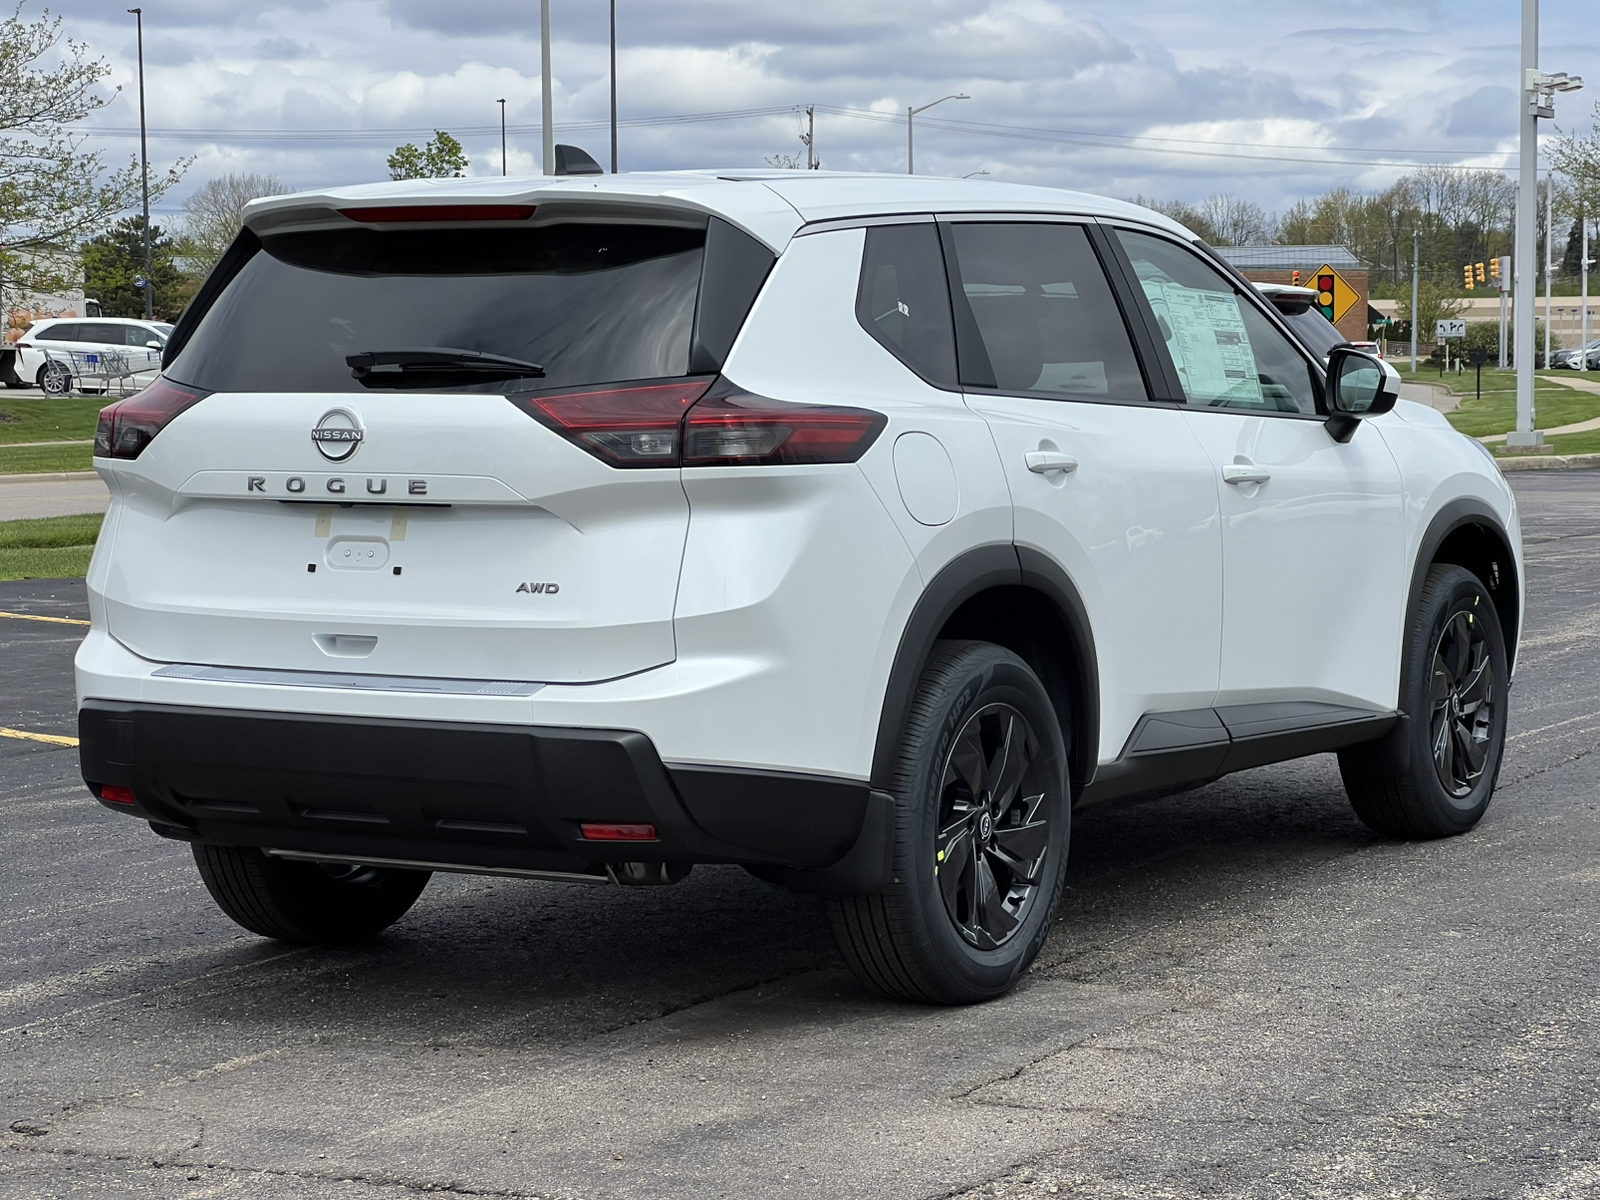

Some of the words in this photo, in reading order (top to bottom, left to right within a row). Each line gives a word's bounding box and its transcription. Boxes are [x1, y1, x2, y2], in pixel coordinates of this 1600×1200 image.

[312, 431, 361, 440] NISSAN
[247, 476, 428, 495] ROGUE
[515, 581, 560, 594] AWD
[948, 688, 972, 729] HP2
